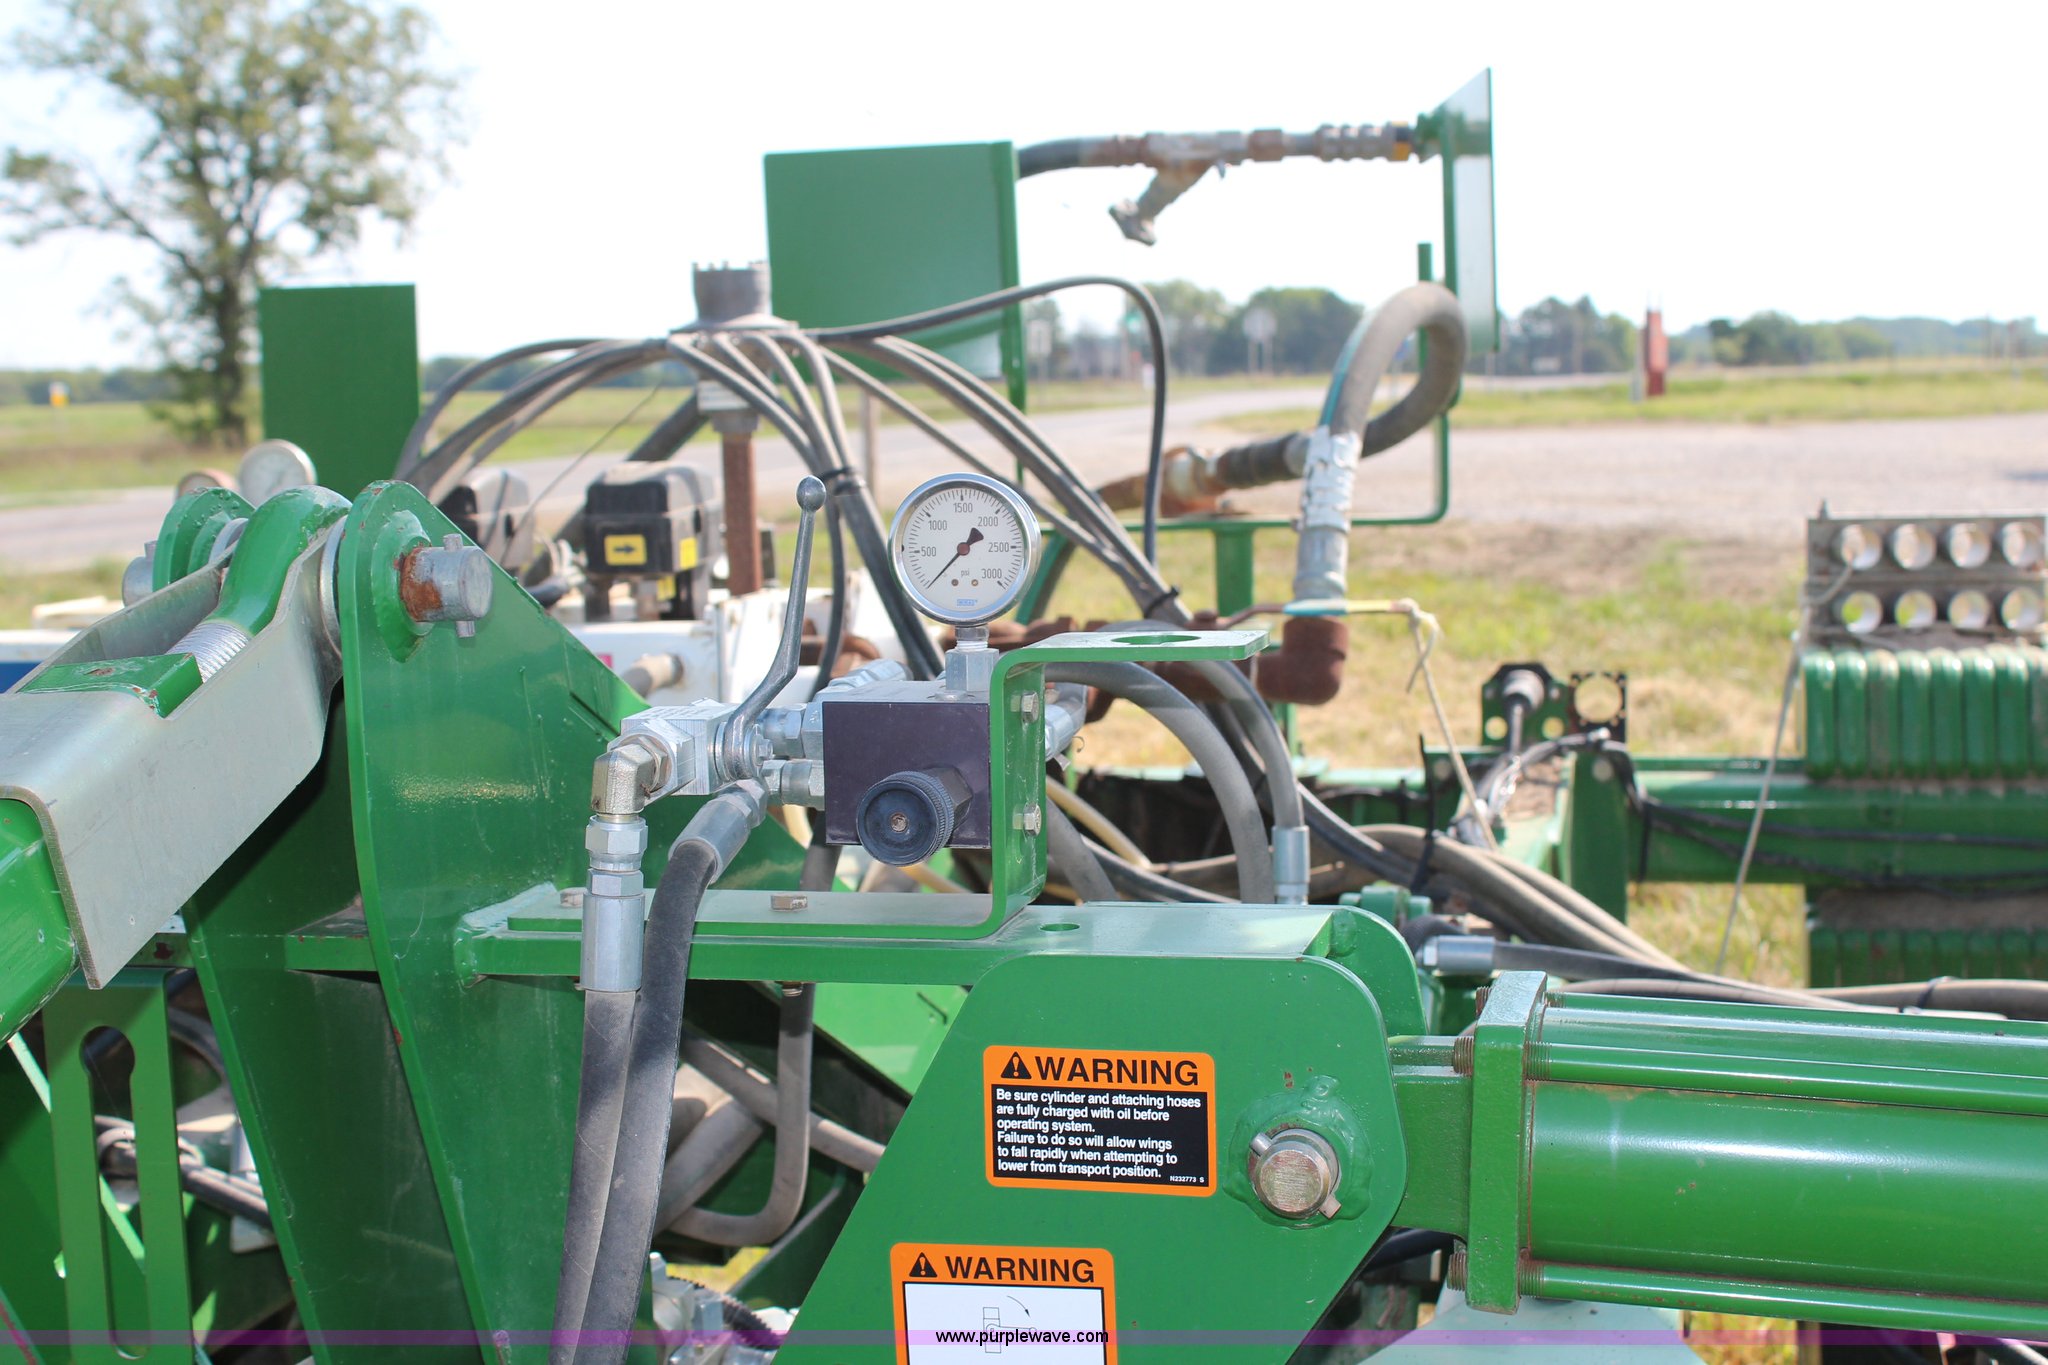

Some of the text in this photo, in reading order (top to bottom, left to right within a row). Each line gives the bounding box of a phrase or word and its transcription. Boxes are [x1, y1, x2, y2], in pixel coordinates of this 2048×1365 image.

[953, 502, 973, 513] 1500
[929, 520, 947, 530] 1000
[978, 517, 998, 527] 2000
[921, 547, 936, 557] 500
[988, 542, 1009, 552] 2500
[961, 568, 970, 577] psi
[982, 569, 1002, 578] 3000
[1035, 1055, 1198, 1086] WARNING
[996, 1088, 1201, 1109] Be sure cylinder and attaching hoses
[996, 1104, 1170, 1121] are fully charged with oil before
[997, 1119, 1095, 1134] operating system.
[997, 1131, 1173, 1152] Failure to do so will allow wings
[997, 1145, 1178, 1166] to fall rapidly when attempting to
[998, 1159, 1161, 1178] lower from transport position.
[944, 1255, 1095, 1283] WARNING
